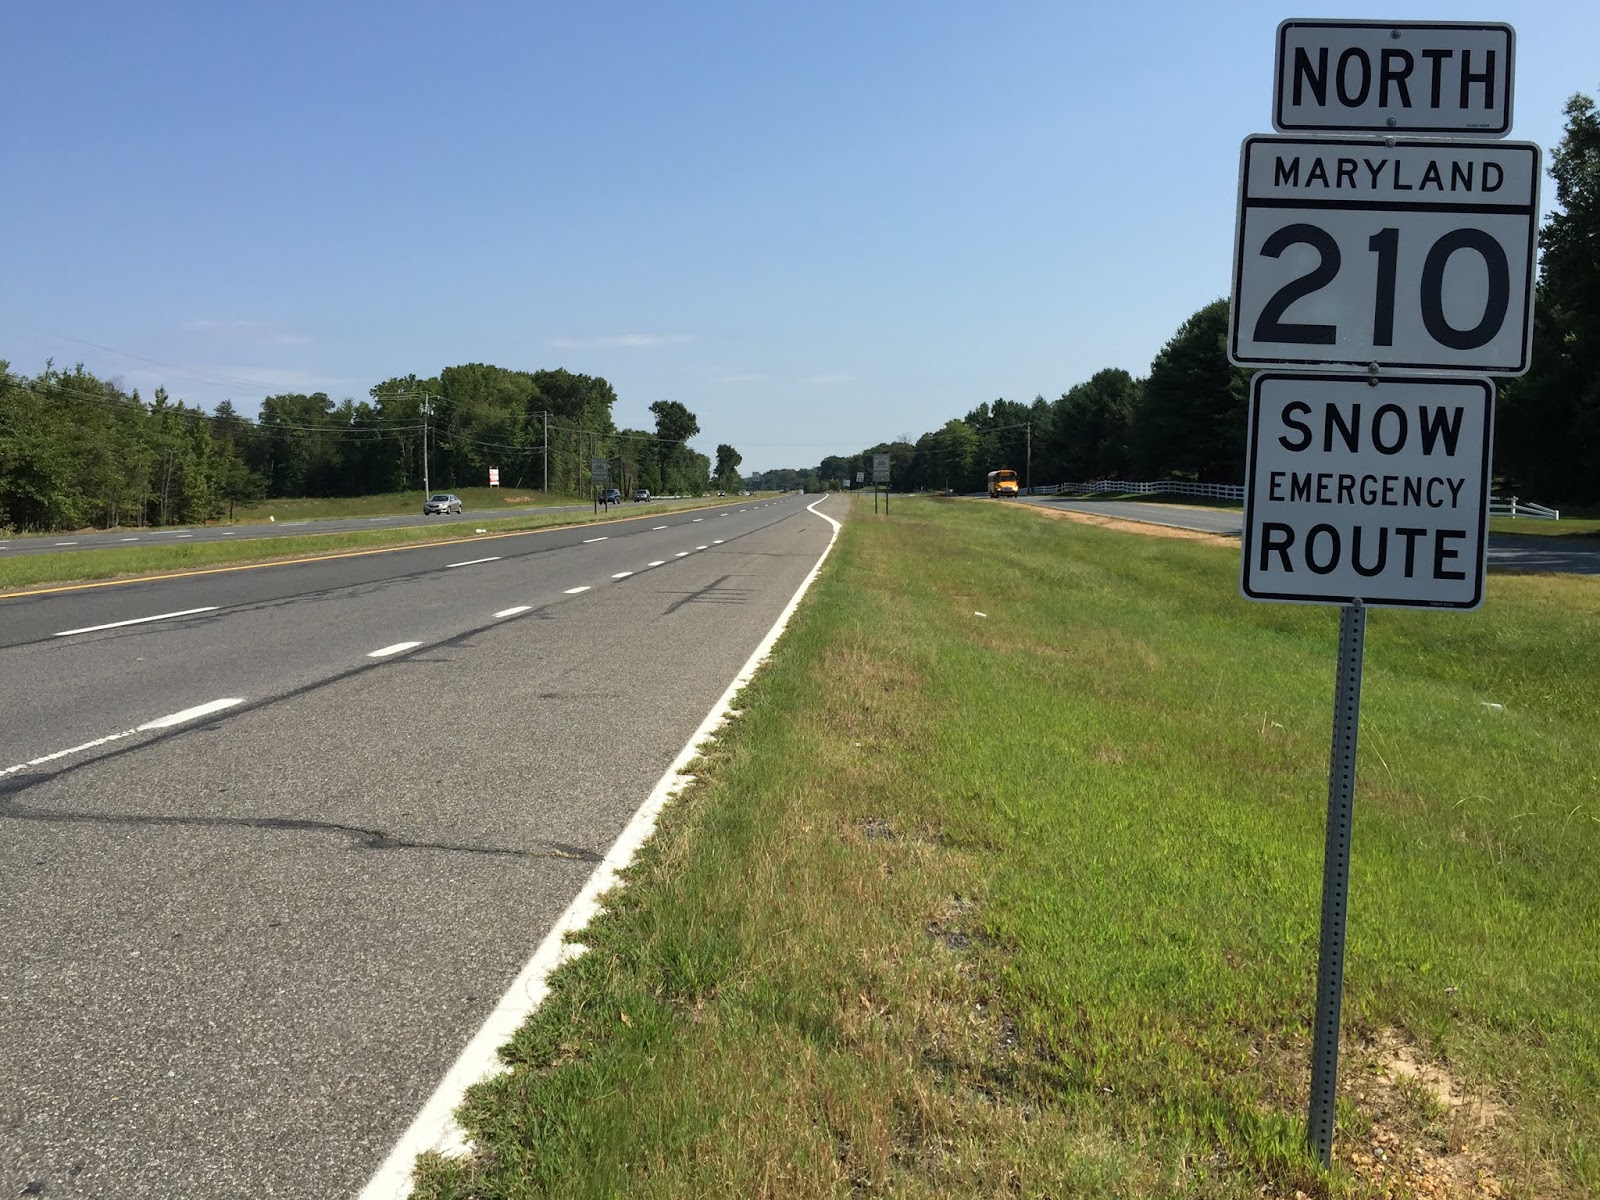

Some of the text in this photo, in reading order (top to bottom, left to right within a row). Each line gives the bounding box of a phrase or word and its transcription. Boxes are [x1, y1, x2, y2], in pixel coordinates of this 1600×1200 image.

[1292, 46, 1496, 110] NORTH
[1274, 156, 1504, 192] MARYLAND
[1253, 223, 1510, 350] 210
[1278, 401, 1464, 457] SNOW
[1269, 471, 1466, 509] EMERGENCY
[1259, 522, 1467, 581] ROUTE
